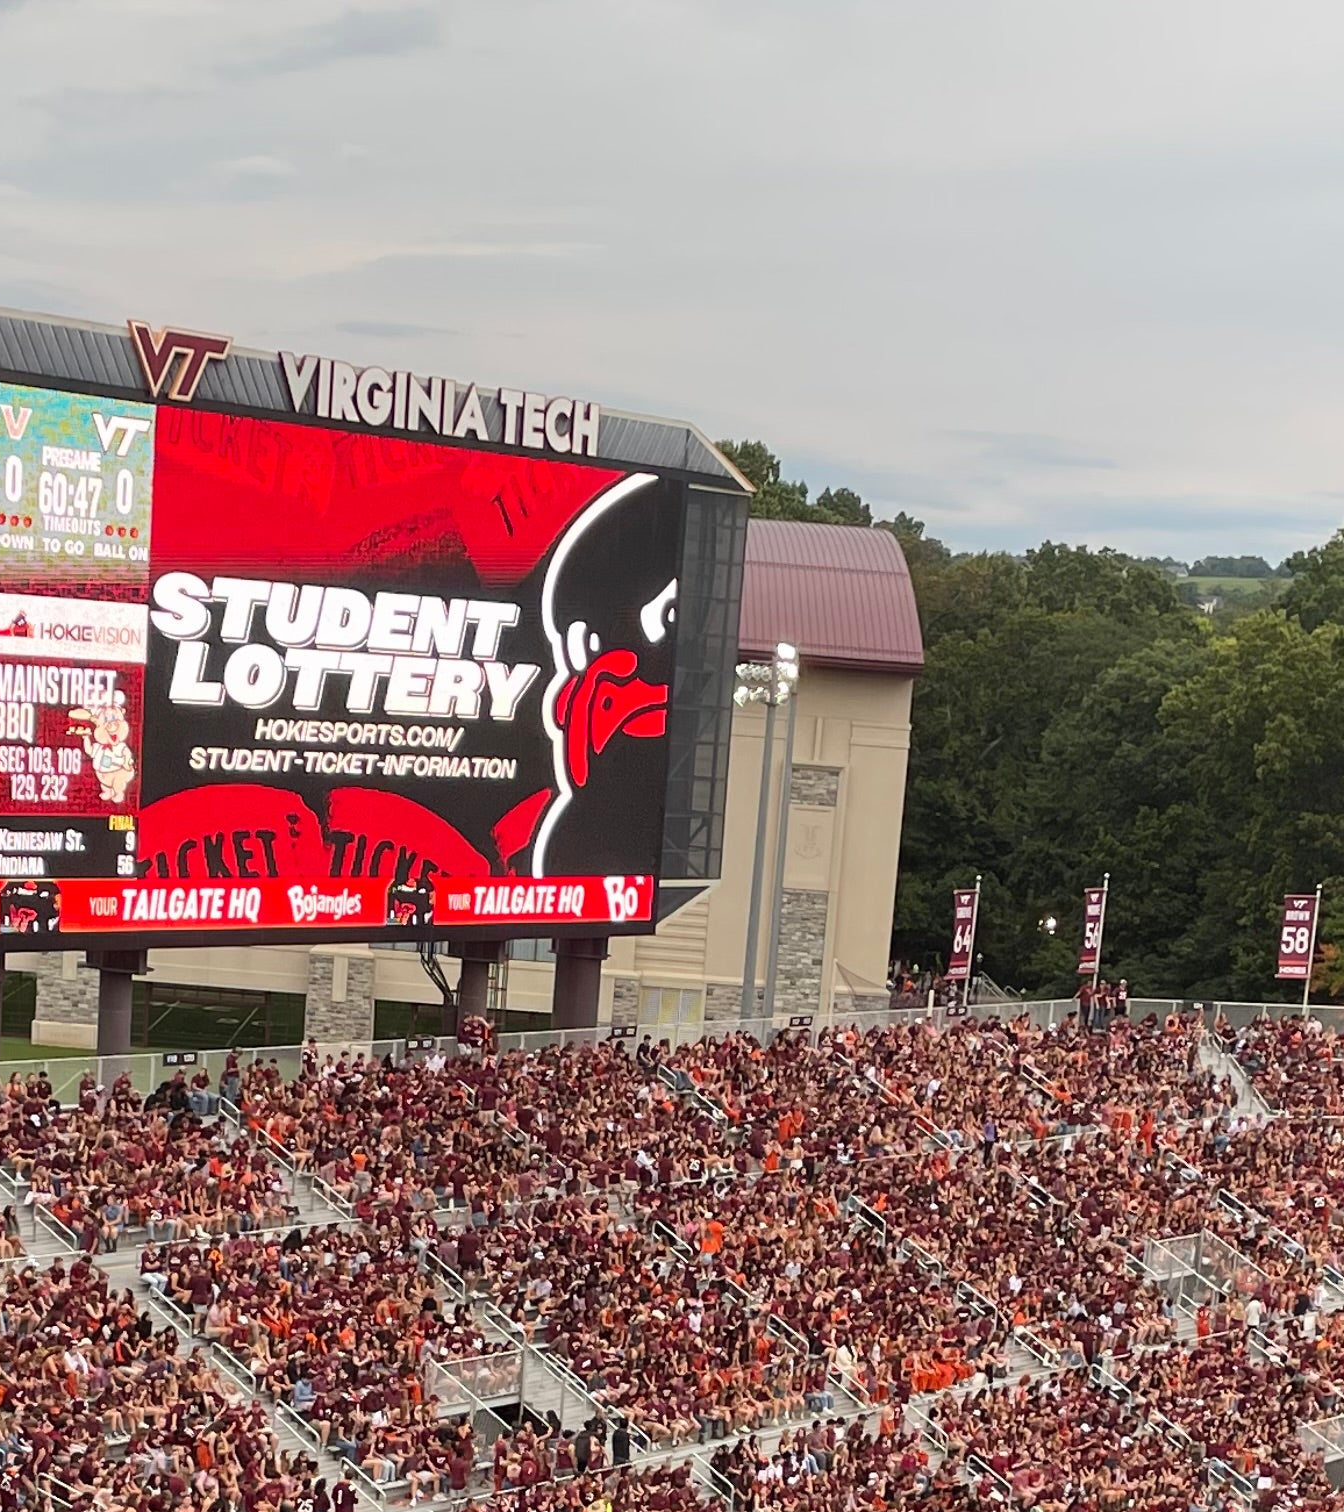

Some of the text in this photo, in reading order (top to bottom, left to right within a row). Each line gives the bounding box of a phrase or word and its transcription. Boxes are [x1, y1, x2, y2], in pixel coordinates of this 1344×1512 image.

[127, 319, 233, 402] VT
[279, 352, 600, 456] VIRGINIA TECH
[0, 404, 32, 440] V
[92, 412, 152, 456] VT
[42, 446, 102, 472] PREGAME
[5, 455, 23, 502] 0
[39, 472, 103, 518] 60:47
[116, 468, 134, 514] 0
[43, 515, 102, 536] TIMEOUTS
[43, 538, 85, 555] TO GO
[94, 543, 148, 561] BALL ON
[150, 571, 520, 661] STUDENT
[168, 640, 542, 721] LOTTERY
[255, 718, 465, 752] HOKIESPORTS.COM/
[27, 747, 55, 775] 103,
[189, 746, 518, 780] STUDENT-TICKET-INFORMATION
[10, 774, 69, 803] 129, 232
[65, 829, 86, 851] ST.
[125, 831, 135, 851] 9
[109, 815, 135, 831] FINAL
[117, 855, 134, 876] 56
[89, 887, 262, 922] YOUR TAILGATE HQ
[287, 884, 362, 923] Bojangles
[447, 886, 586, 917] YOUR TAILGATE HQ
[952, 924, 972, 954] 64
[1280, 926, 1310, 955] 58
